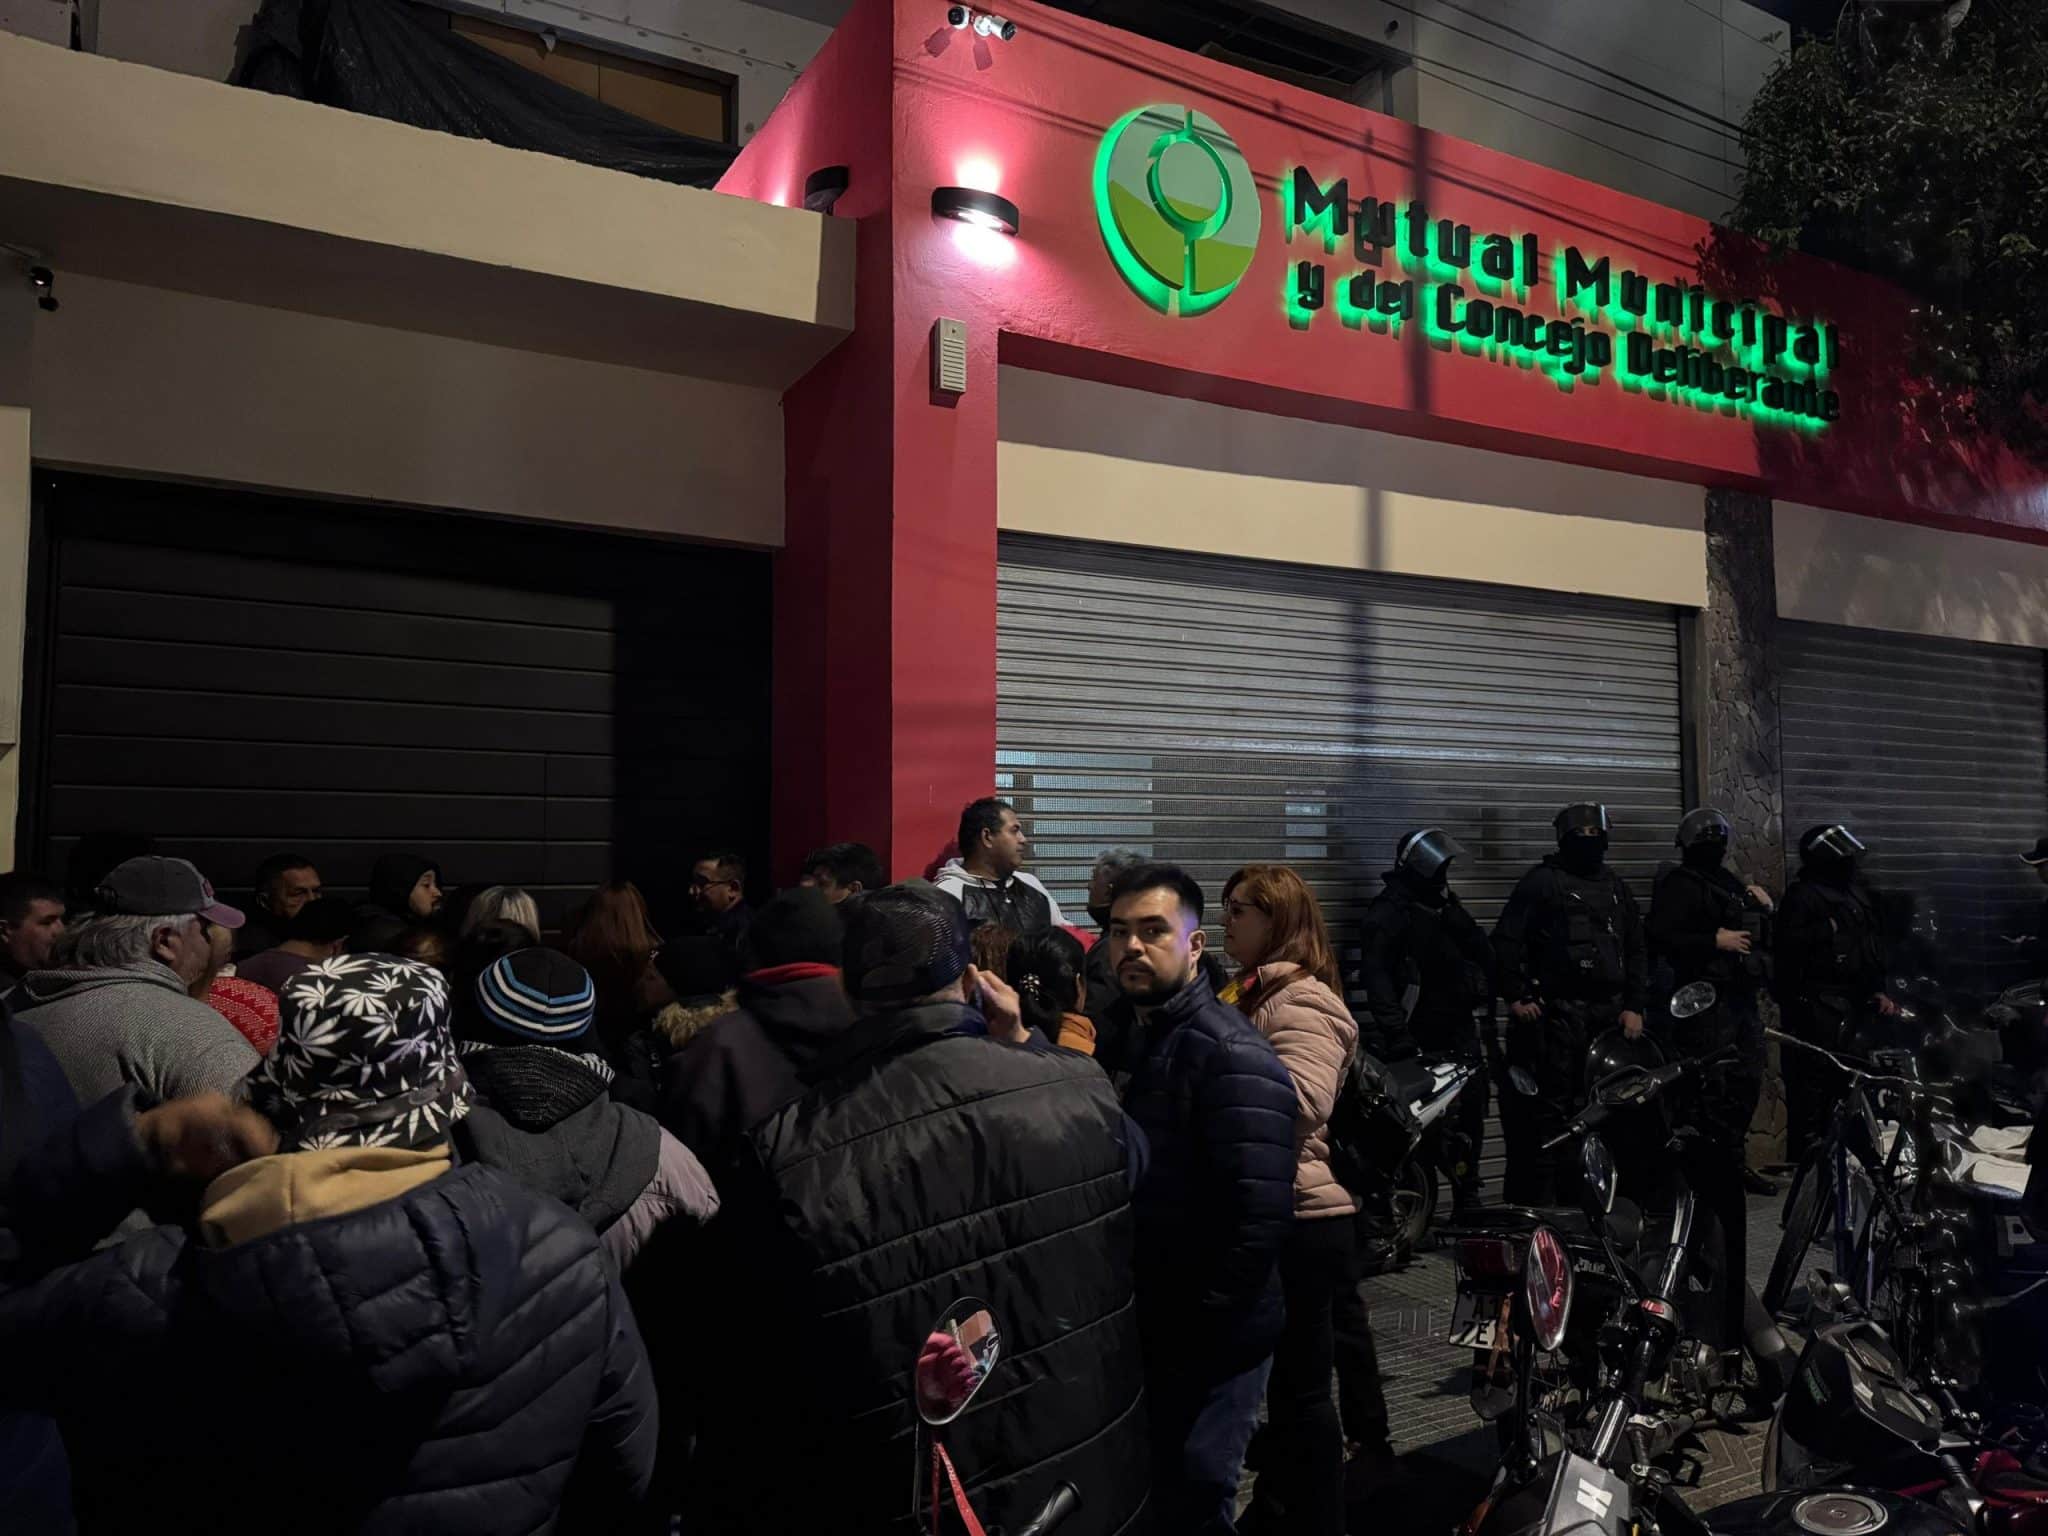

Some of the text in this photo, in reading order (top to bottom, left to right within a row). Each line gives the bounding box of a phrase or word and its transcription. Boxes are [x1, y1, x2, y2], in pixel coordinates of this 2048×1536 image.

[1293, 165, 1839, 369] Mutual Municipal
[1297, 260, 1841, 423] y del Concejo Deliberante
